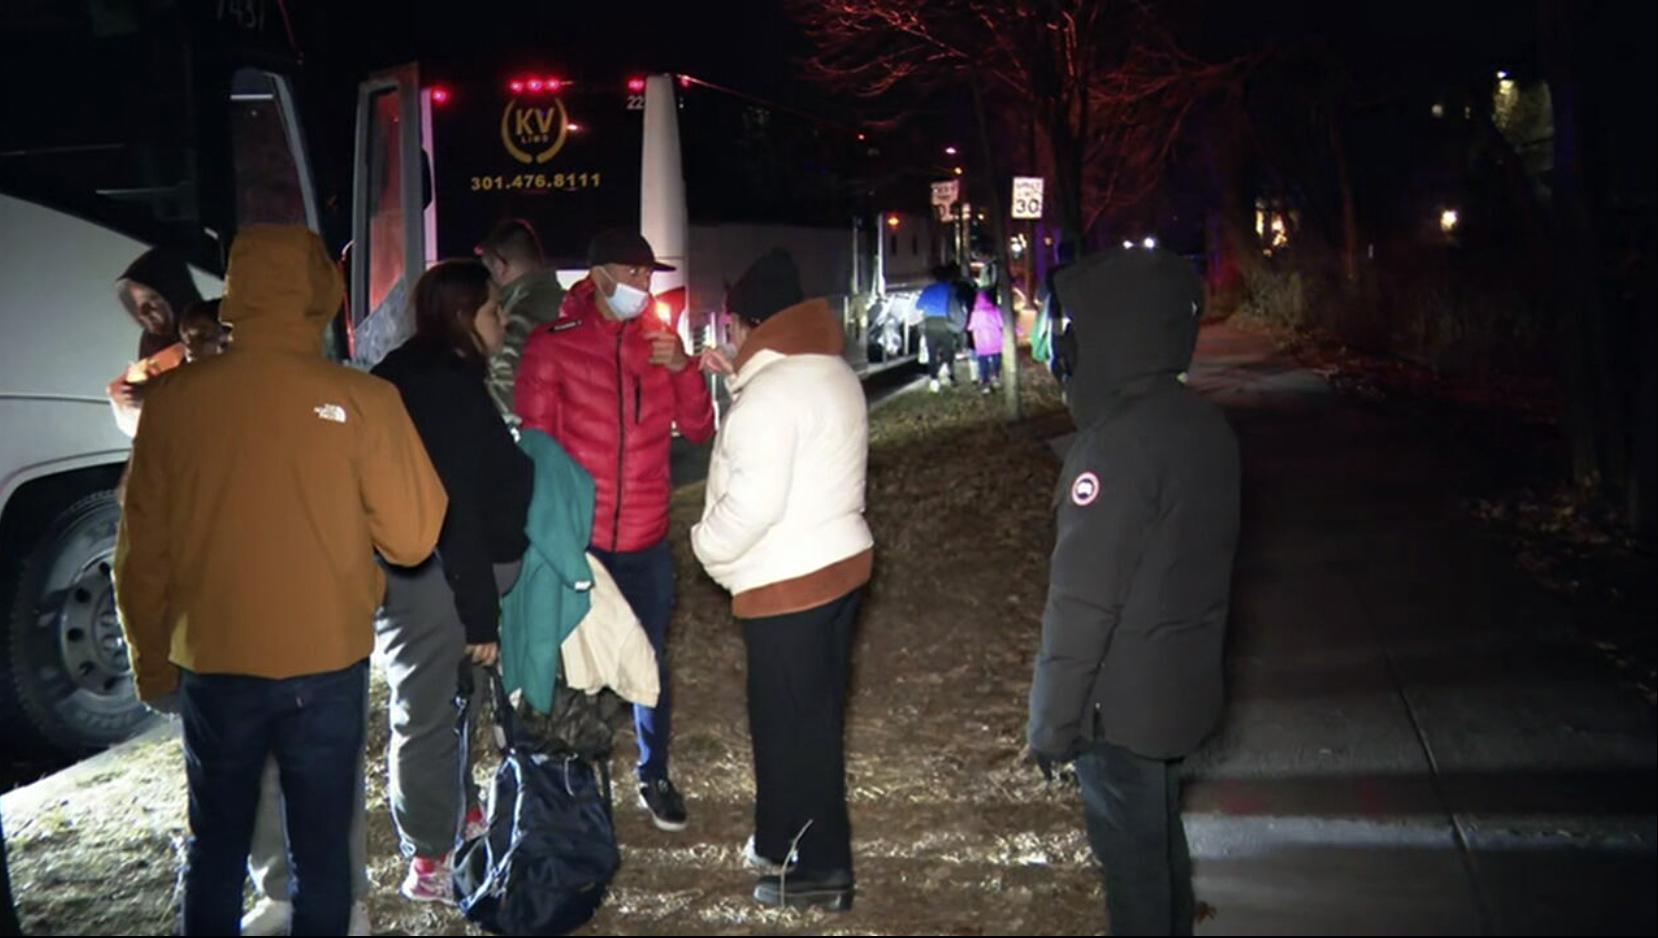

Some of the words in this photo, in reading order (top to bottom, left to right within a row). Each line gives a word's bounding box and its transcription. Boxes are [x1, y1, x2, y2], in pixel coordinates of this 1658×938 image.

[516, 107, 555, 135] KV
[471, 173, 602, 191] 301.476.8111
[1015, 197, 1040, 214] 30
